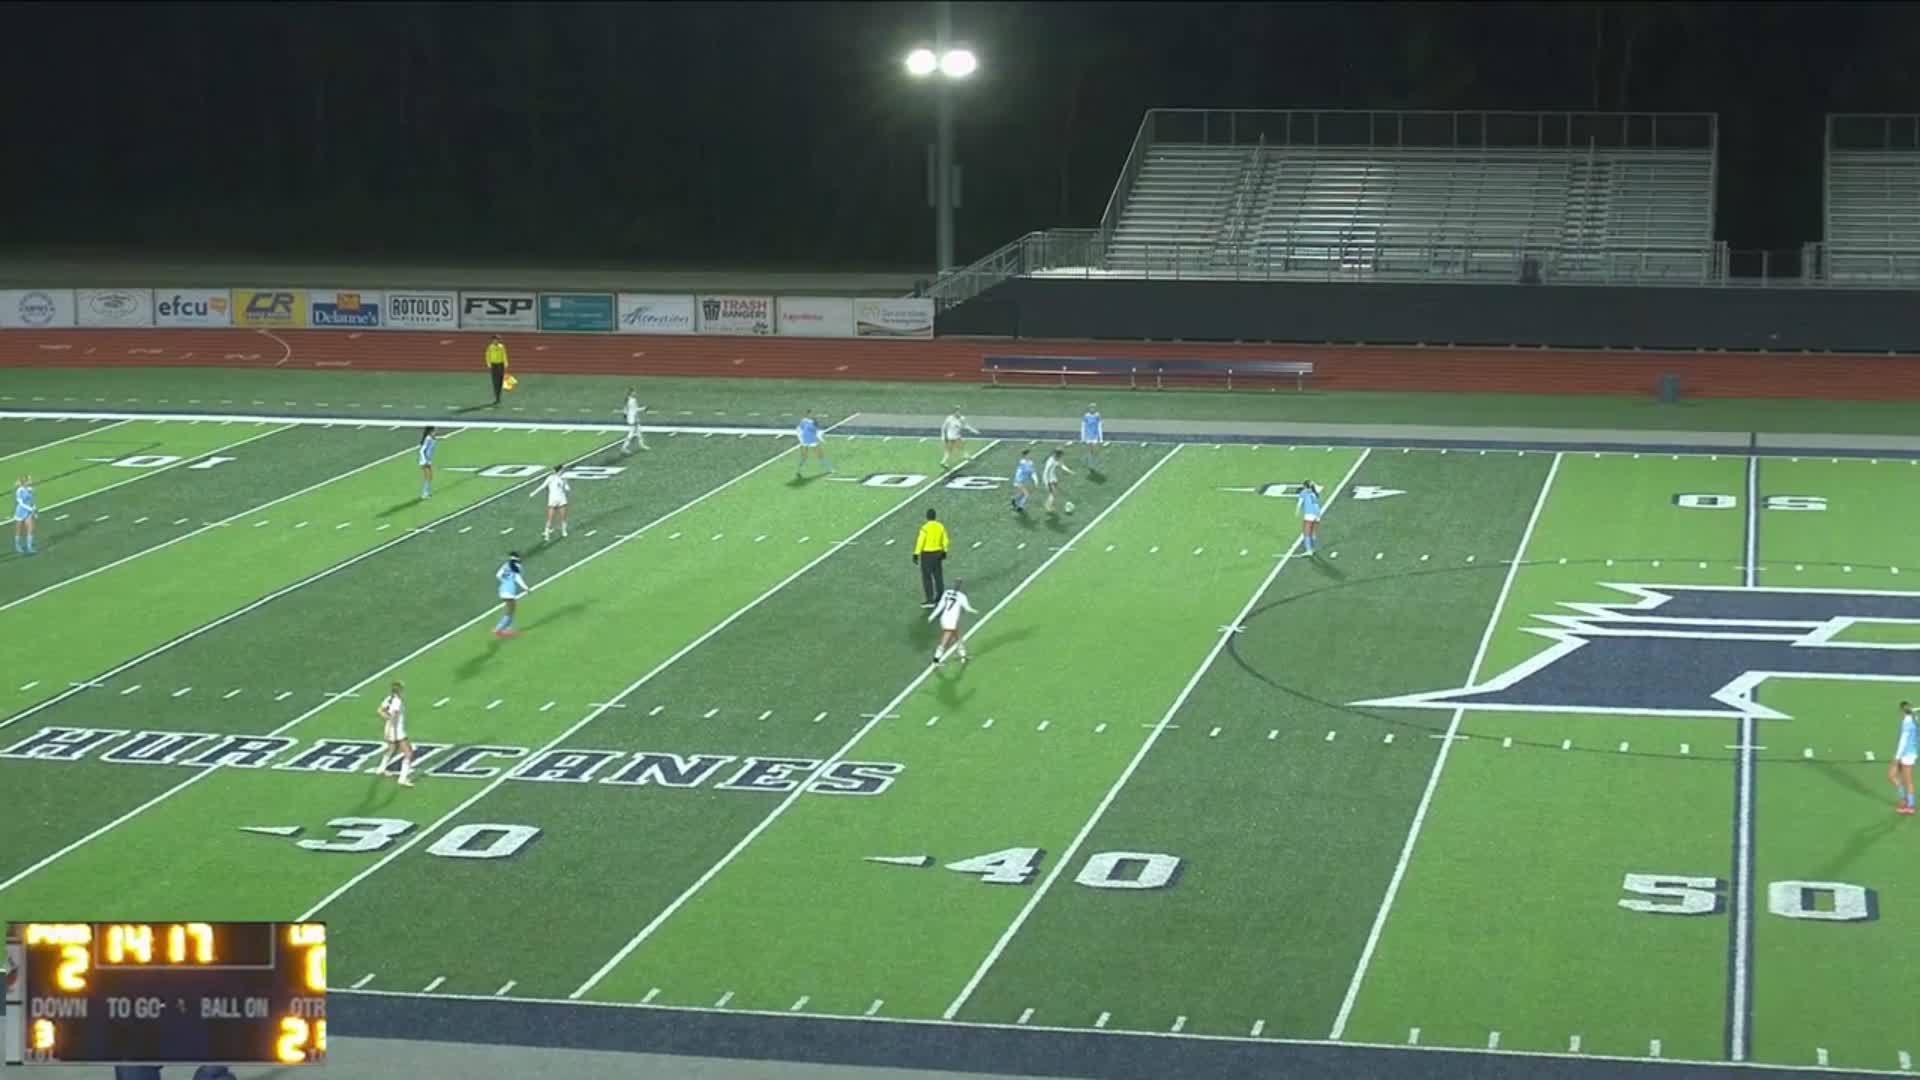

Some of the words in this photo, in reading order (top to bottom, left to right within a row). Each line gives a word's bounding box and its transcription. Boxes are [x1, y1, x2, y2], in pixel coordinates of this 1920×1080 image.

[158, 295, 208, 316] efcu
[464, 297, 533, 315] FSP
[721, 298, 768, 310] TRASH
[721, 309, 768, 319] RANGERS
[1, 727, 905, 795] HURRICANES
